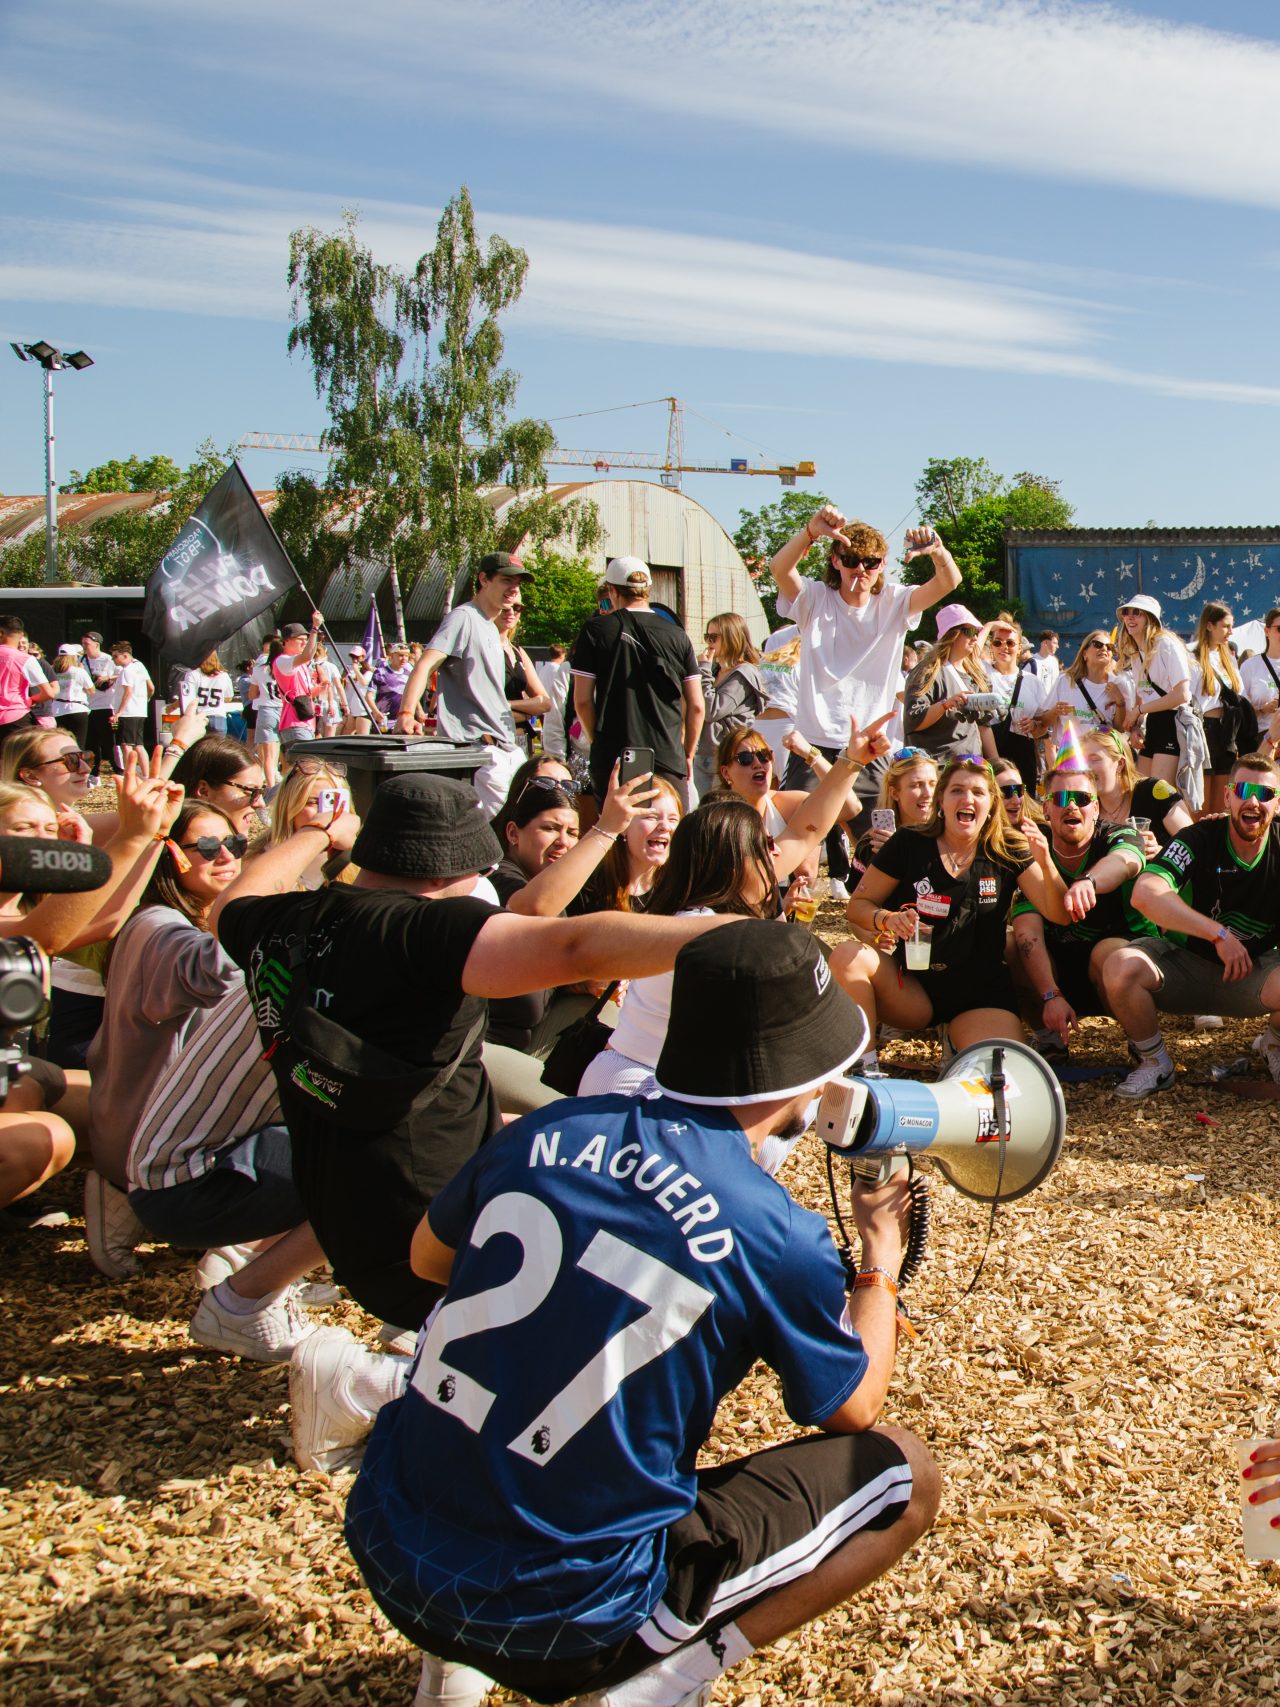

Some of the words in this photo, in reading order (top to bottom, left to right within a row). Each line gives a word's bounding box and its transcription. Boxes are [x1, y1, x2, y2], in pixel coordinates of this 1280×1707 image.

[198, 686, 222, 707] 55
[30, 849, 92, 872] RØDE
[1164, 847, 1186, 872] HSD
[1168, 841, 1193, 866] RUN
[906, 1118, 933, 1127] MONACOR
[411, 1191, 715, 1467] 27
